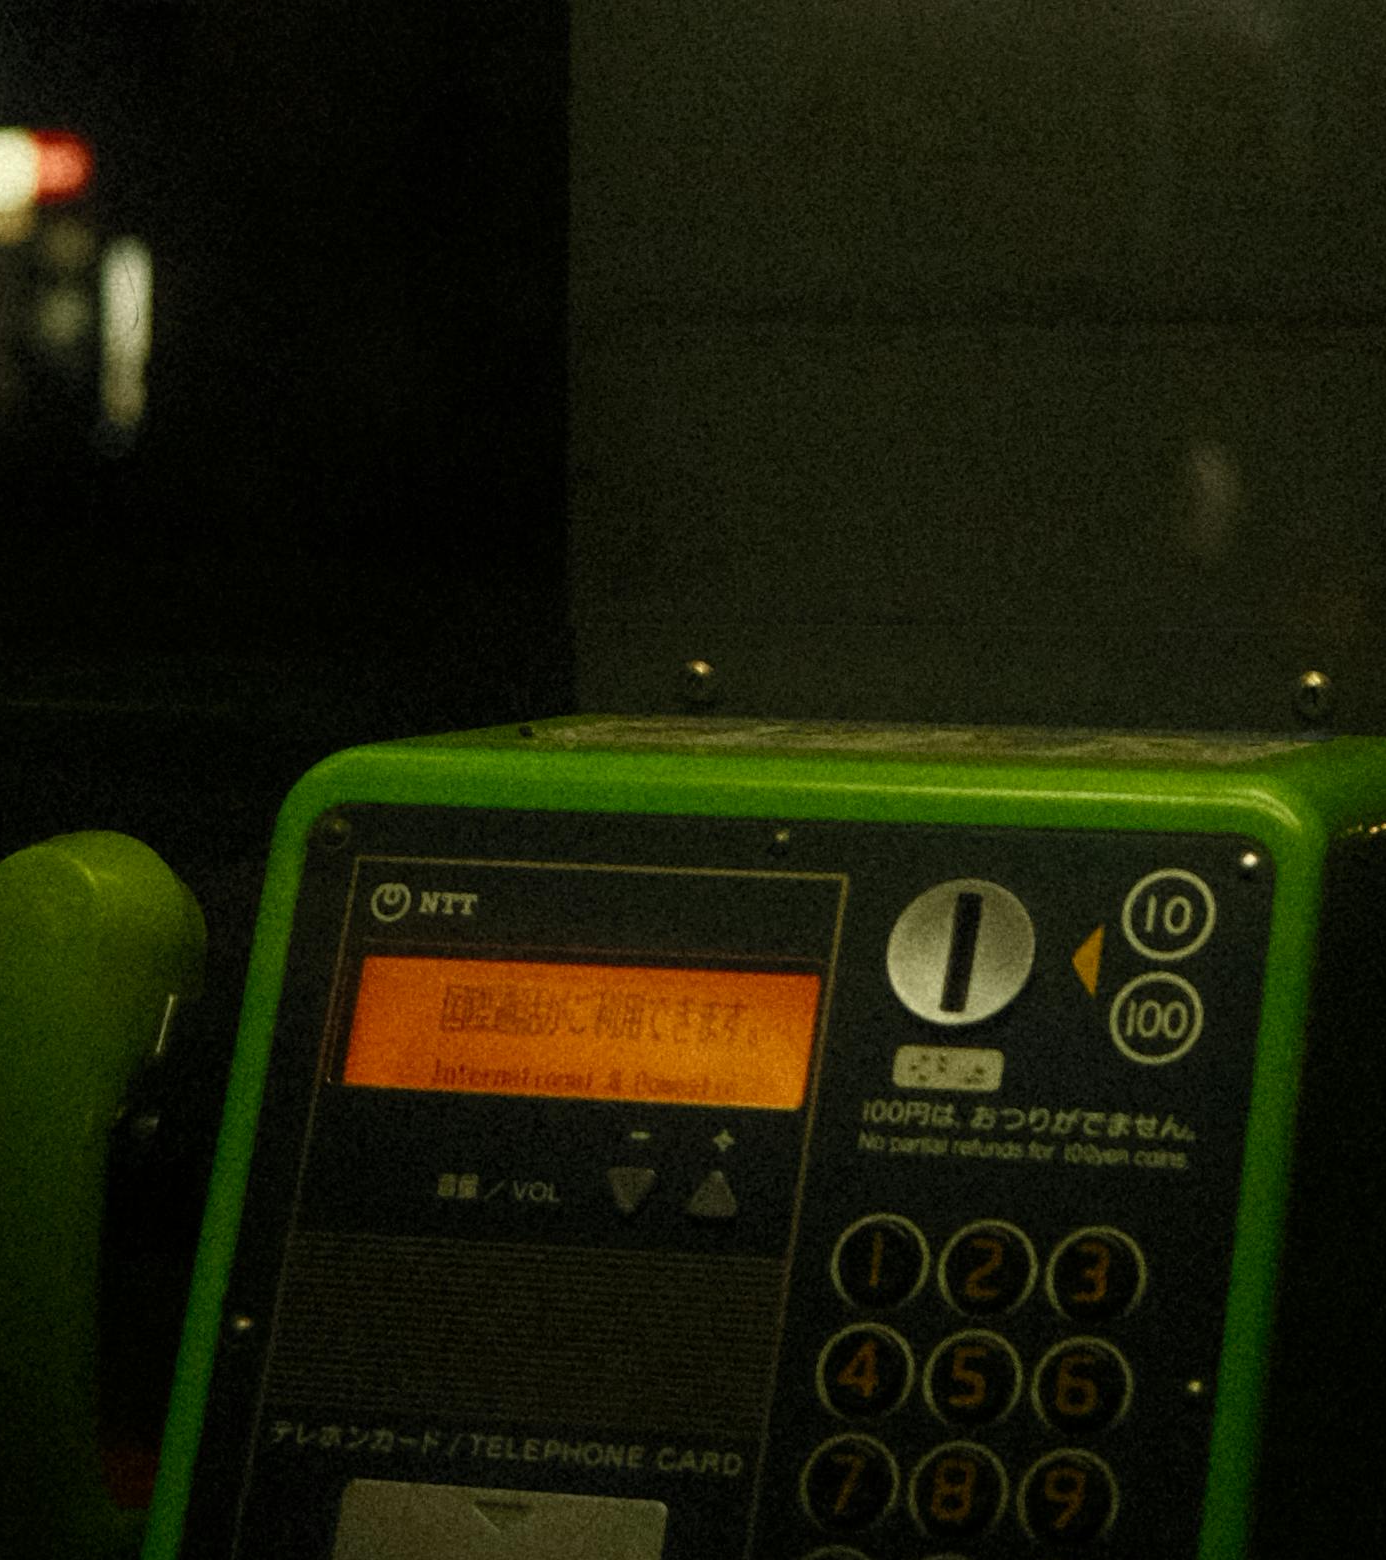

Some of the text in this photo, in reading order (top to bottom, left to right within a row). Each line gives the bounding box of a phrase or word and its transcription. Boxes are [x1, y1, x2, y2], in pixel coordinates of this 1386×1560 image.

[418, 891, 481, 919] NTT
[1142, 895, 1194, 934] 10
[1123, 999, 1190, 1040] 100
[857, 1130, 886, 1152] No
[953, 1136, 1025, 1160] refunds
[1028, 1140, 1055, 1160] for
[868, 1231, 883, 1288] 1
[964, 1238, 1004, 1301] 2
[1071, 1242, 1112, 1305] 3
[836, 1338, 881, 1401] 4
[948, 1345, 990, 1410] 5
[1053, 1354, 1099, 1418] 6
[657, 1447, 744, 1478] CARD
[831, 1453, 867, 1515] 7
[928, 1457, 977, 1523] 8
[1042, 1466, 1087, 1532] 9
